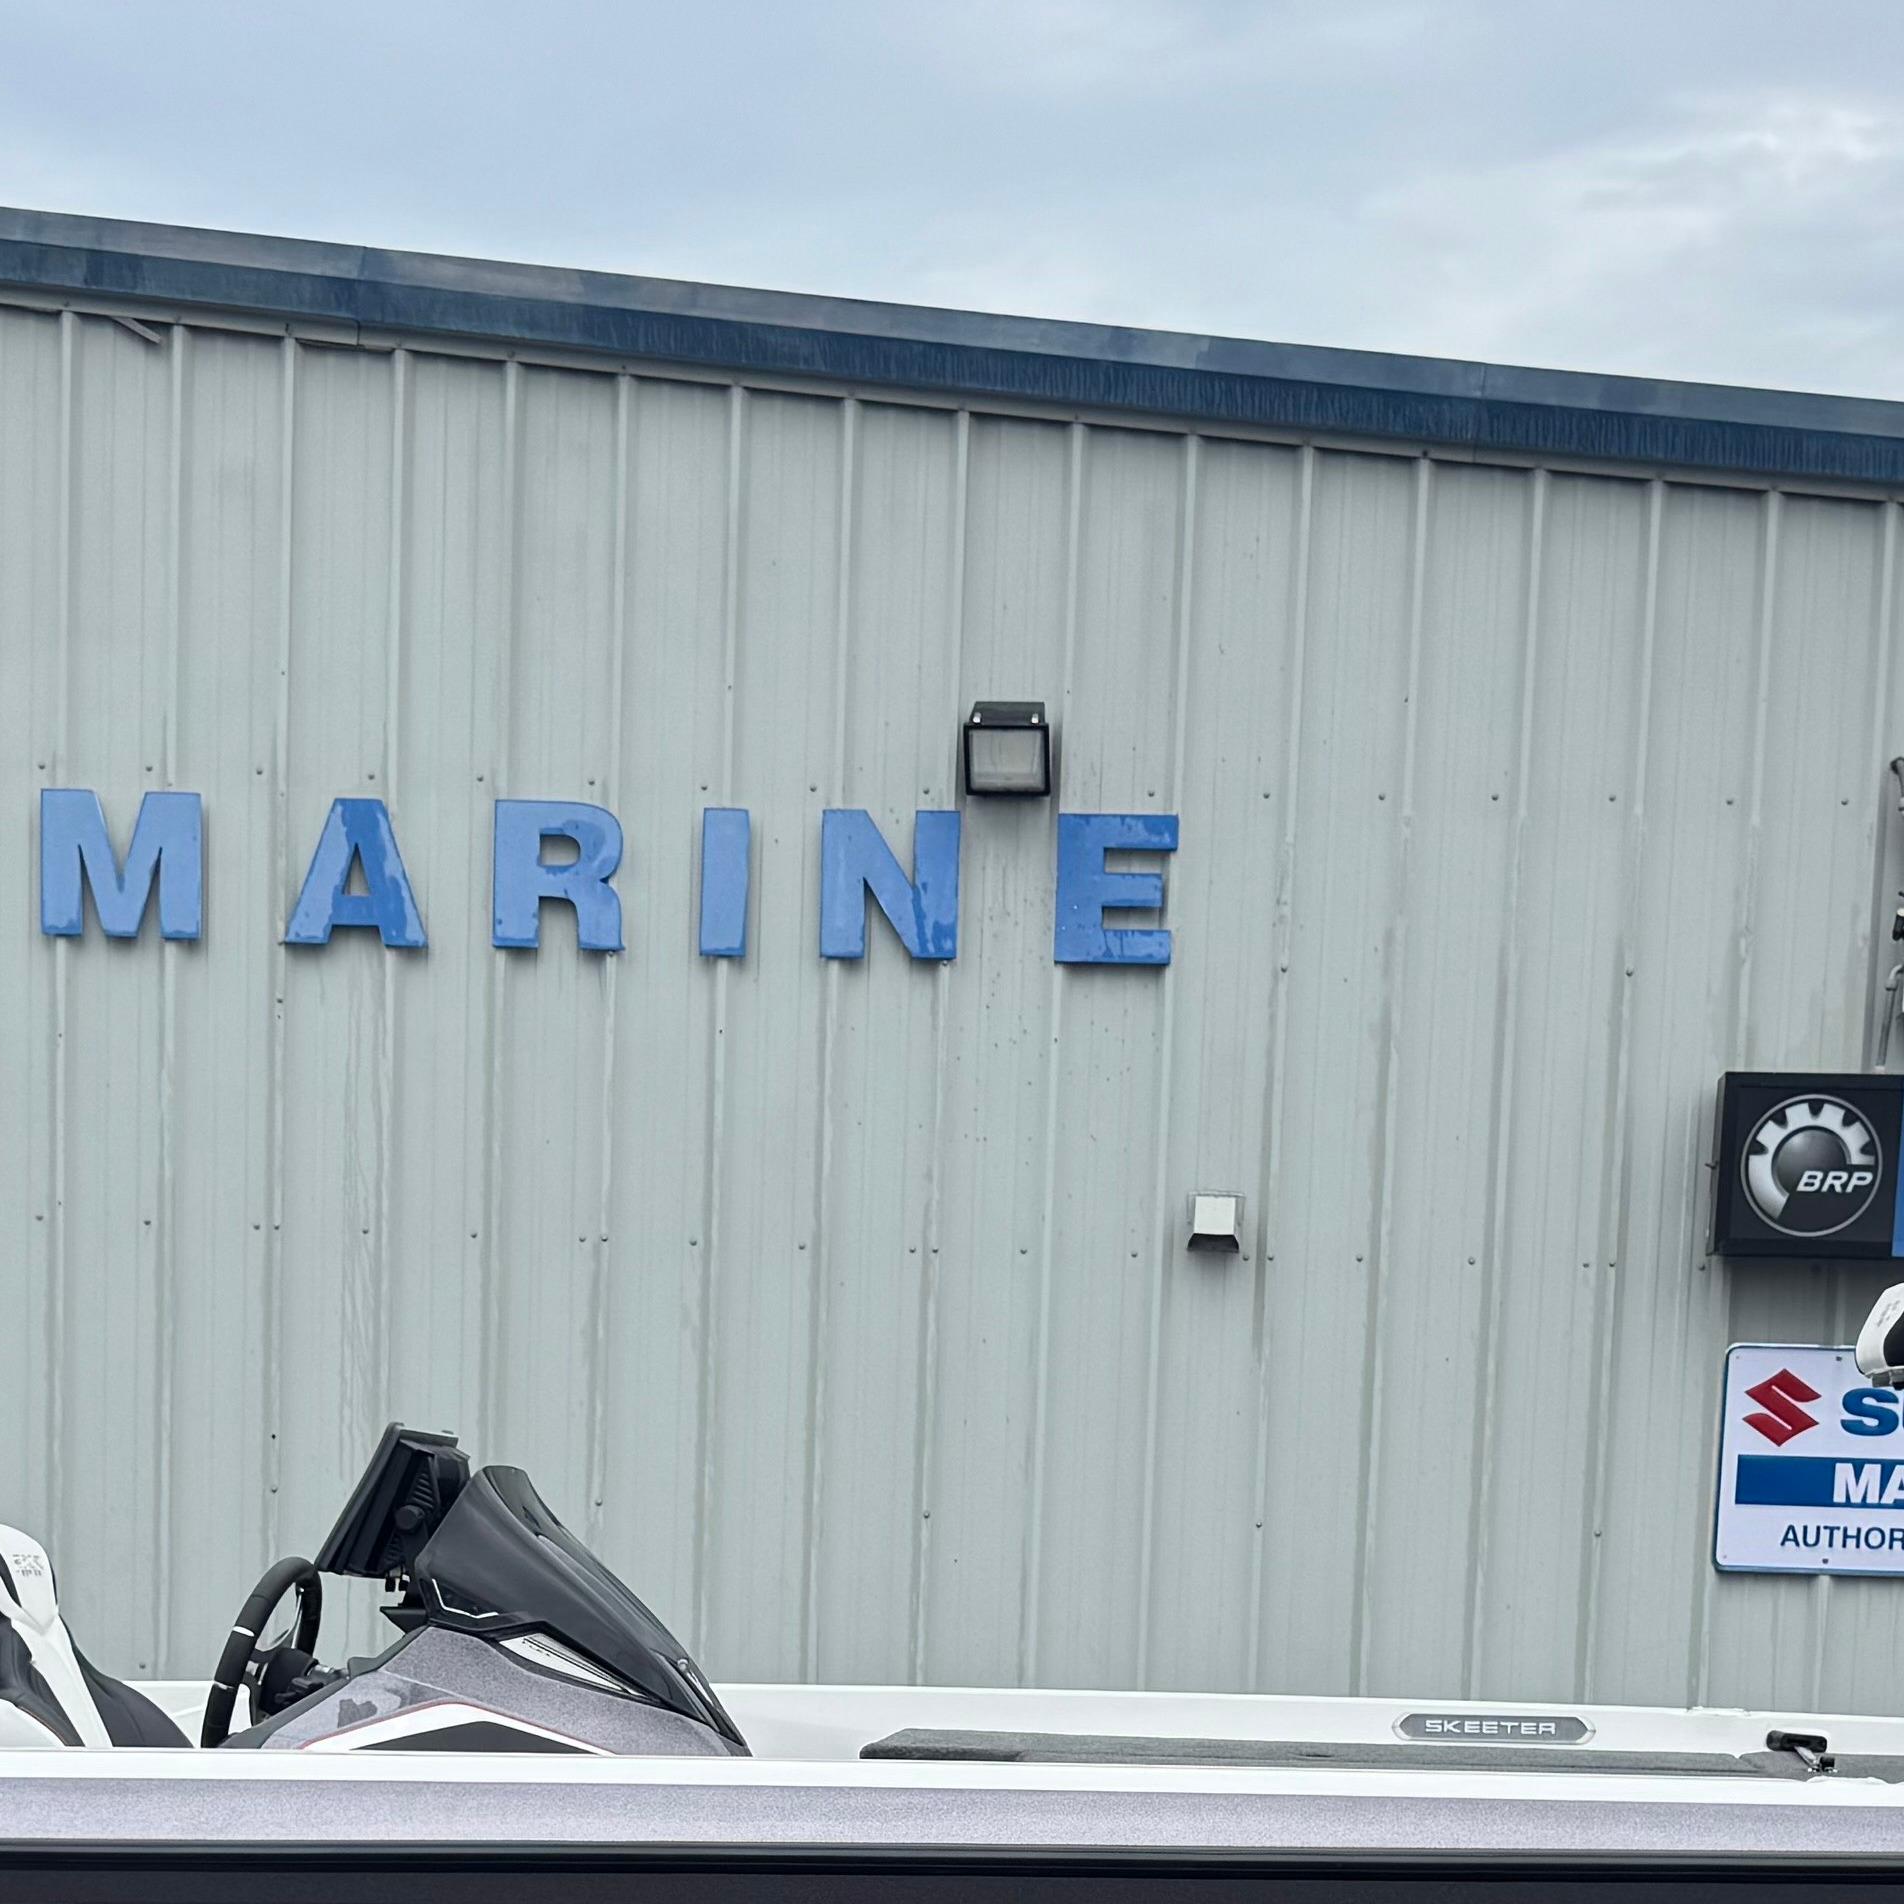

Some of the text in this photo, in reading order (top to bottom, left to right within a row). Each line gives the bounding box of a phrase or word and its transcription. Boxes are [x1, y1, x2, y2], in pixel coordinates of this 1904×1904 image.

[40, 788, 1180, 966] MARINE
[1796, 1170, 1873, 1193] BRP
[1424, 1719, 1556, 1736] SKEETER
